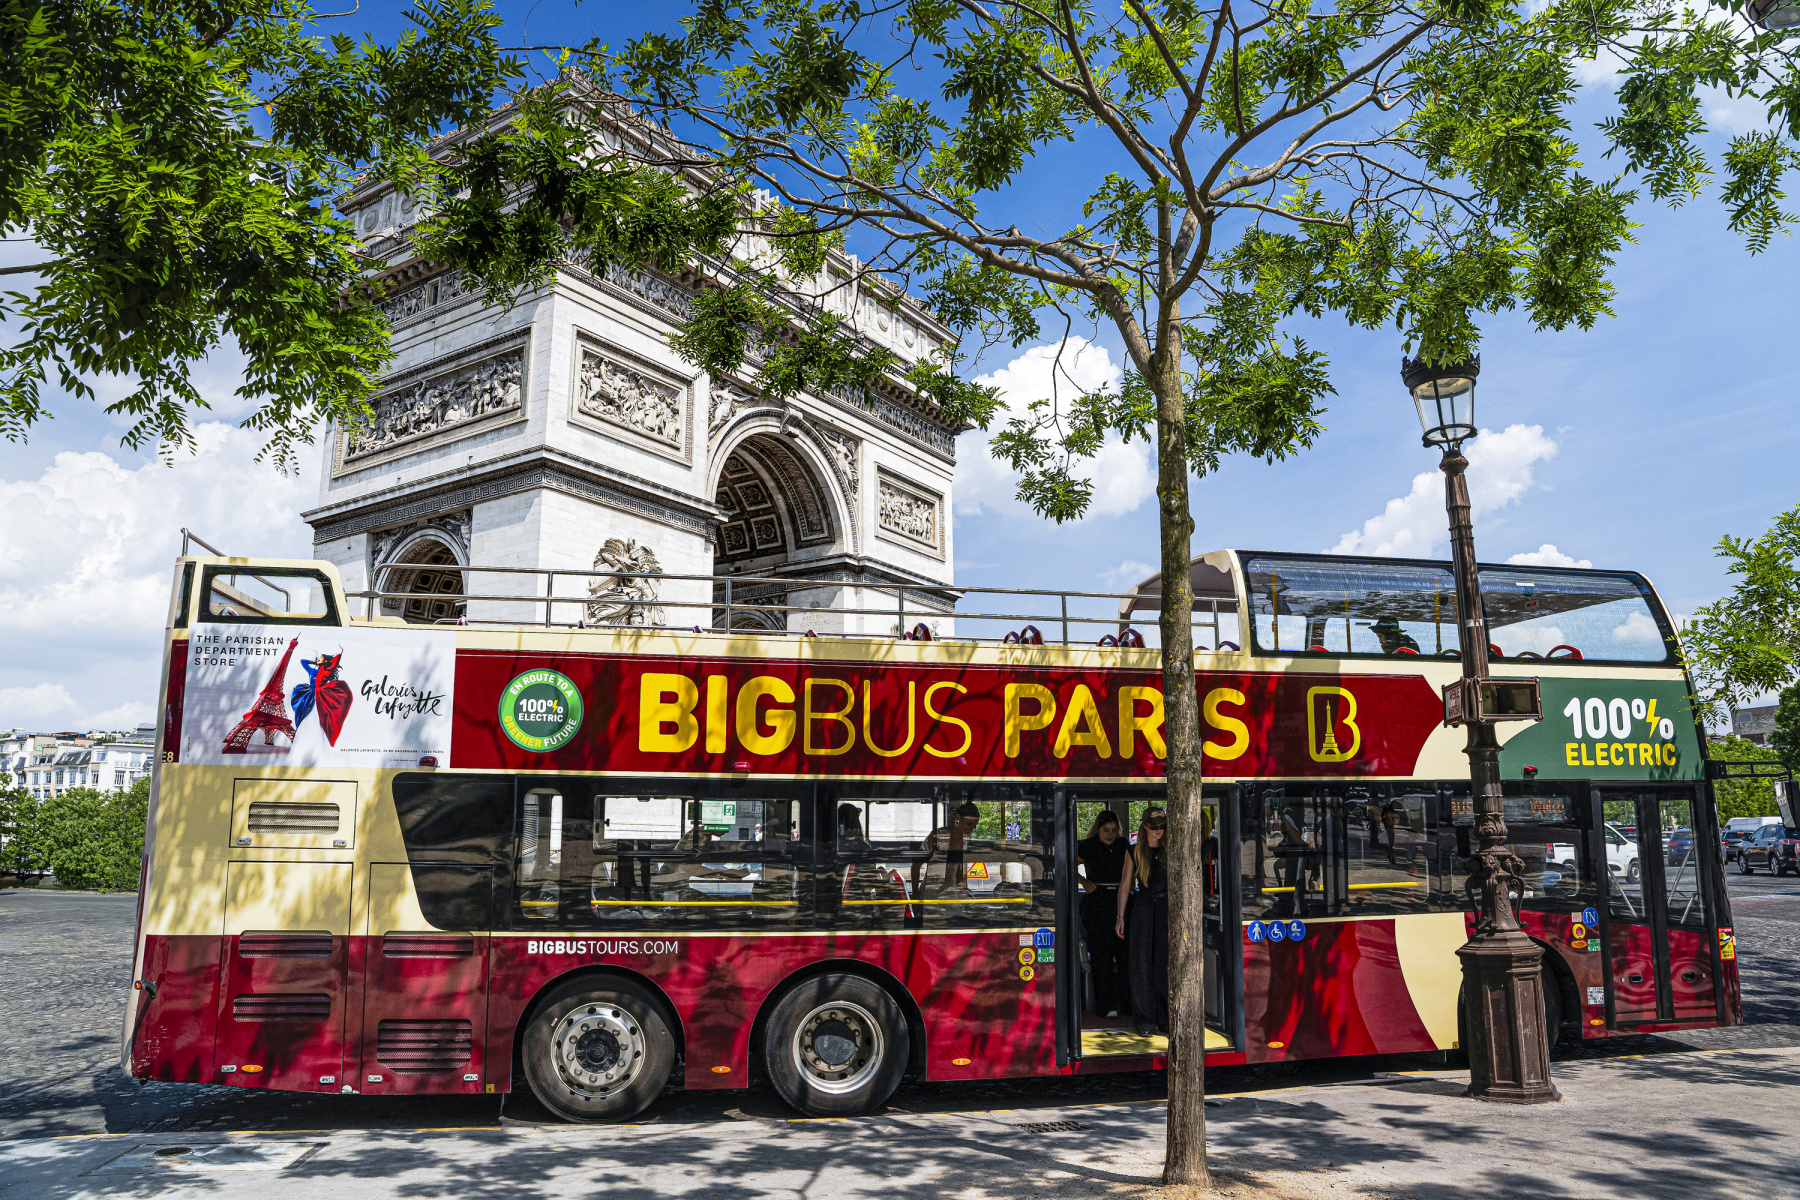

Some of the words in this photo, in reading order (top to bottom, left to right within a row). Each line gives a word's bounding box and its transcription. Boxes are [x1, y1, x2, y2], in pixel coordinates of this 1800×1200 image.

[197, 635, 220, 644] THE
[225, 635, 284, 645] PARISIAN
[195, 646, 278, 656] DEPARTMENT
[361, 675, 417, 701] Galeries
[509, 681, 523, 695] EN
[522, 673, 555, 686] ROUTE
[556, 677, 568, 690] TO
[565, 689, 574, 697] A
[374, 691, 446, 720] Lafayette
[519, 698, 564, 714] 100%
[518, 713, 563, 722] ELECTRIC
[1004, 682, 1250, 761] PARS
[1563, 697, 1674, 740] 100%
[504, 715, 541, 748] GREENER
[543, 718, 577, 747] FUTURE
[1565, 743, 1677, 766] ELECTRIC
[1585, 911, 1596, 924] IN
[527, 940, 679, 955] BIGBUSTOURS.COM
[1036, 932, 1052, 946] EXIT
